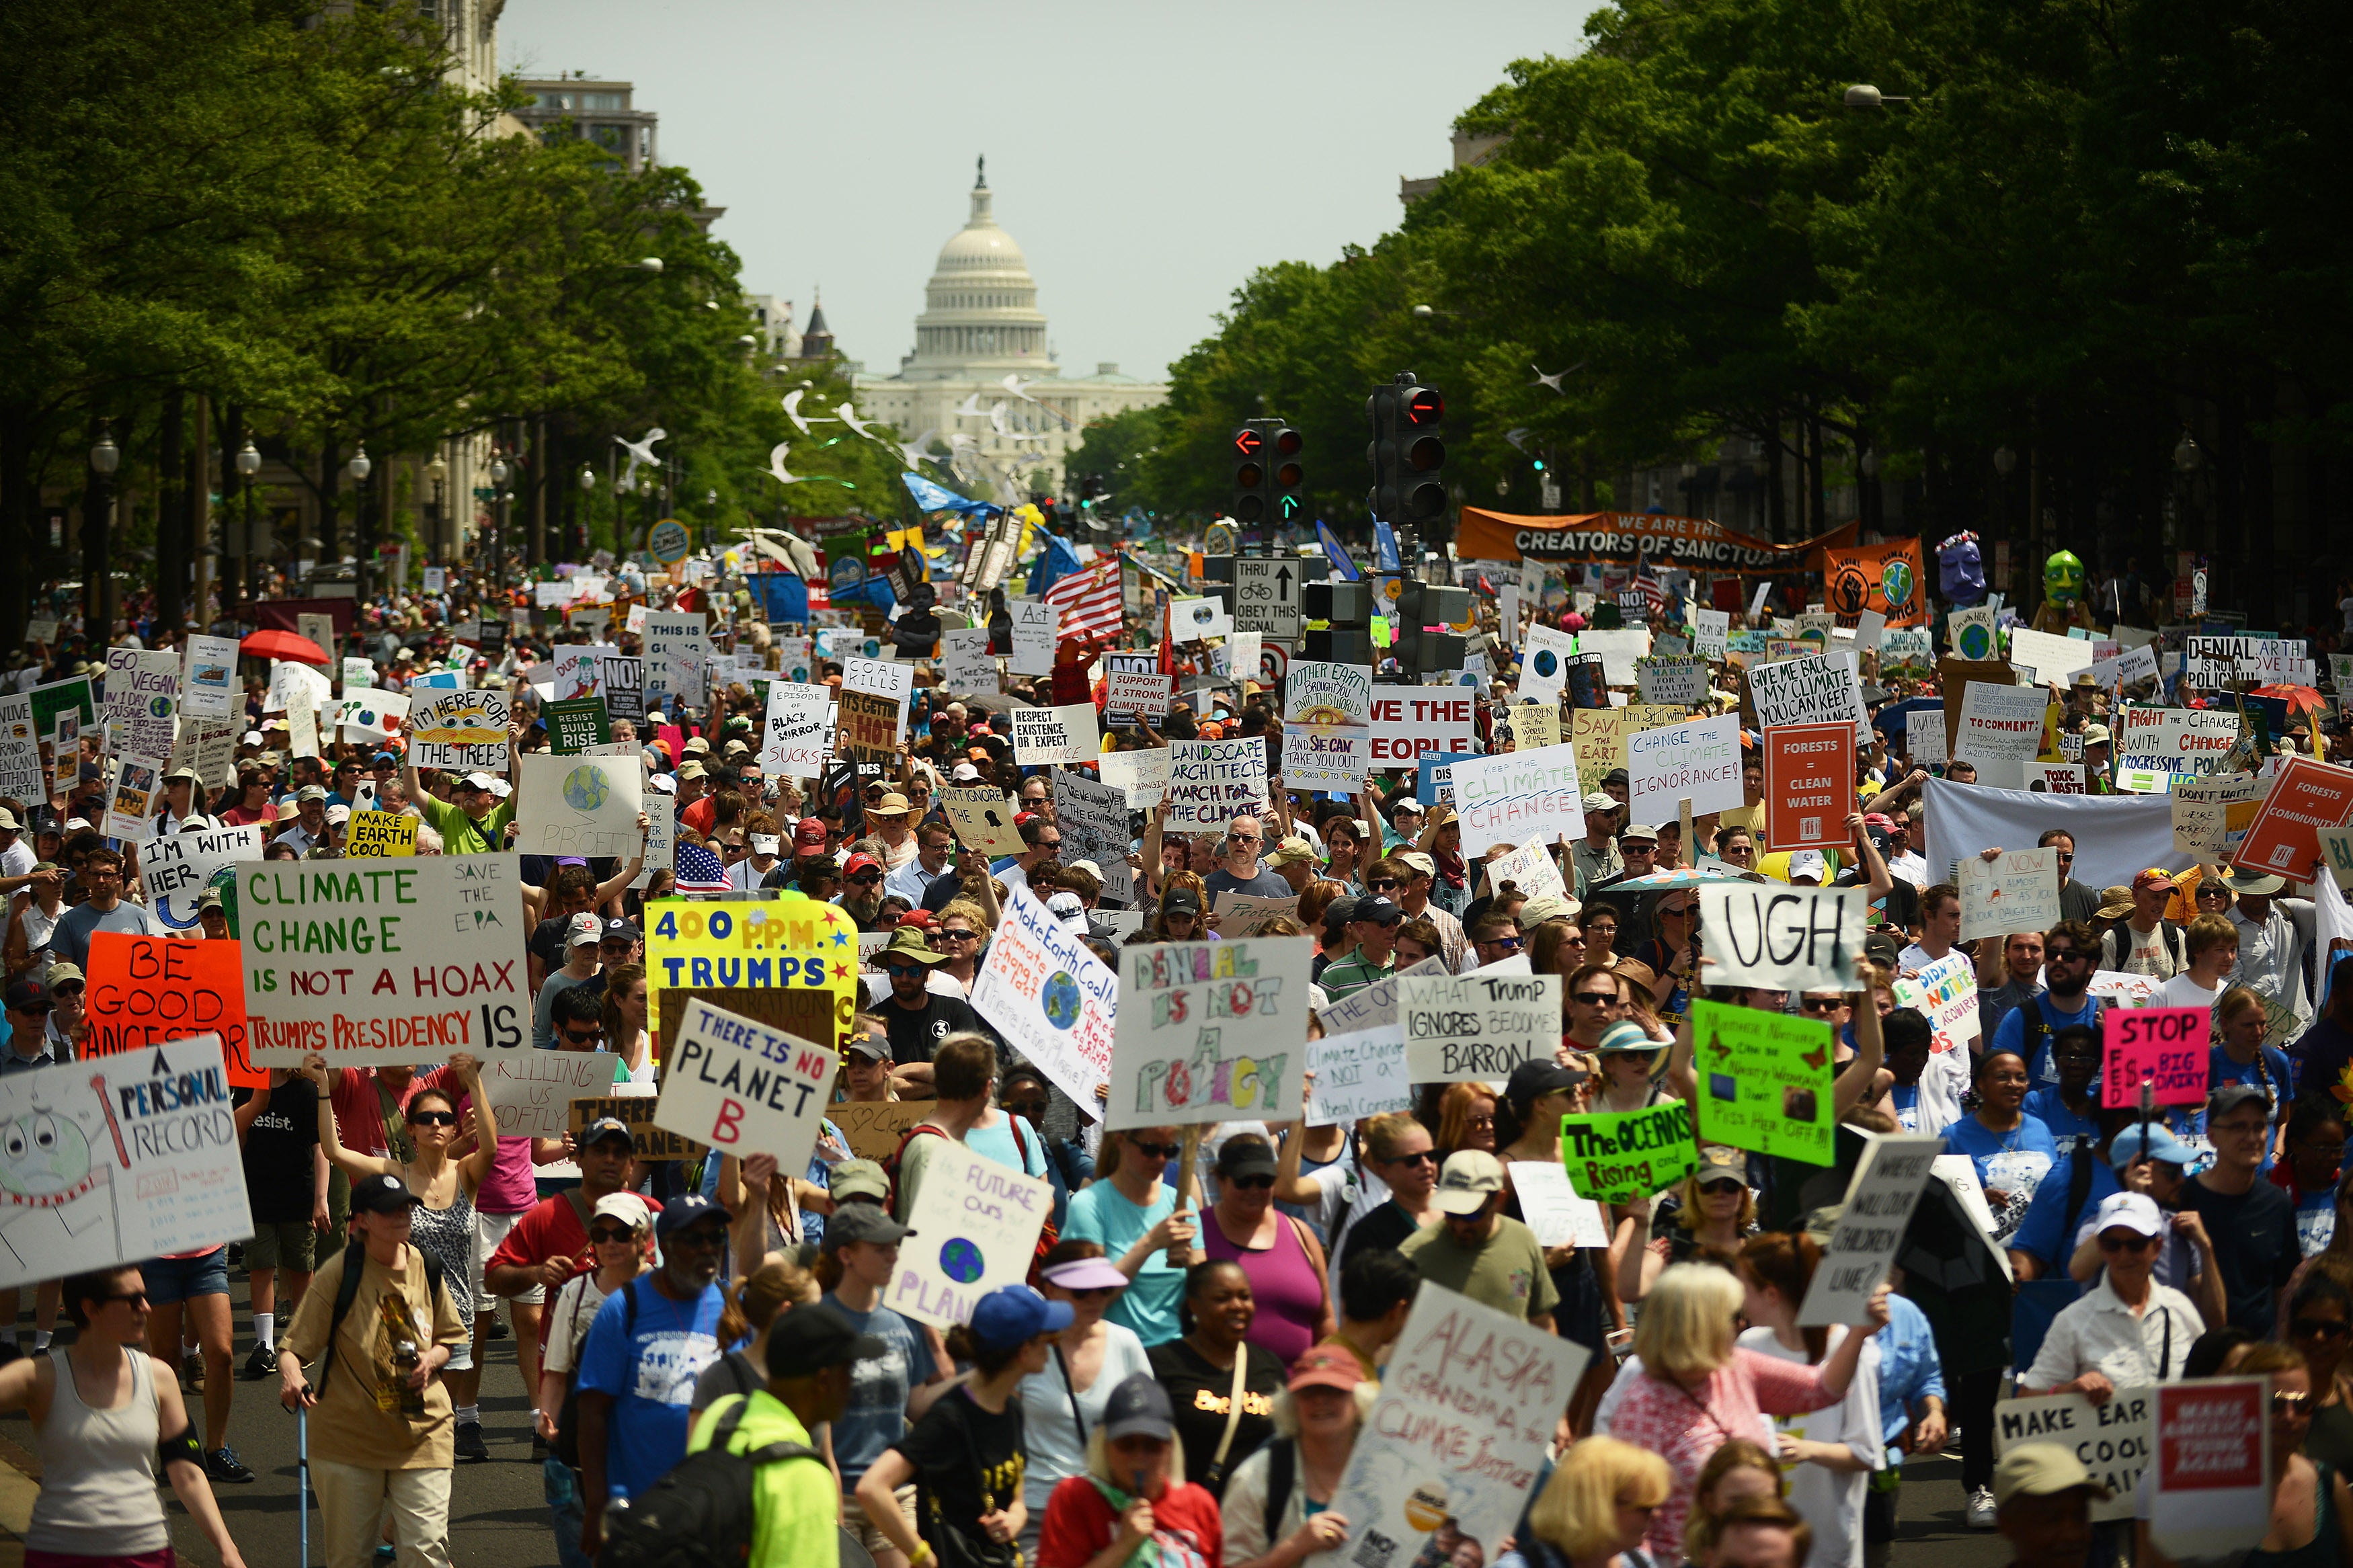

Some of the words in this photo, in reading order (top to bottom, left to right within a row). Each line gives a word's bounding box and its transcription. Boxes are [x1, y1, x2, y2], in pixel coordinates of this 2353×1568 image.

[1618, 516, 1644, 530] WE
[1650, 518, 1686, 532] ARE
[1515, 530, 1636, 552] CREATORS
[1638, 535, 1667, 554] OF
[1239, 564, 1269, 576] THRU
[1022, 605, 1049, 622] Act
[1238, 605, 1267, 617] OBEY
[1273, 606, 1296, 618] THIS
[651, 625, 683, 636] THIS
[686, 626, 699, 636] IS
[1238, 620, 1277, 632] SIGNAL
[951, 638, 967, 651] Tar
[1531, 635, 1550, 645] GOLDEN
[2188, 638, 2255, 660] DENIAL
[108, 651, 138, 670] GO
[849, 660, 900, 677] COAL
[1567, 657, 1580, 665] NO
[1644, 657, 1701, 668] CLIMATE
[605, 659, 641, 689] NO!
[1652, 667, 1693, 676] MARCH
[1750, 667, 1776, 689] GIVE
[1780, 661, 1799, 682] ME
[1801, 654, 1831, 677] BACK
[130, 671, 177, 695] VEGAN
[785, 684, 811, 692] THIS
[848, 673, 899, 691] KILLS
[1116, 675, 1163, 687] SUPPORT
[1286, 663, 1328, 704] MOTHER
[1331, 663, 1371, 707] EARTH
[1651, 684, 1696, 692] HEALTHY
[1790, 668, 1853, 699] CLIMATE
[1976, 684, 2001, 694] KEEP
[106, 692, 117, 702] IN
[128, 692, 148, 706] DAY
[776, 692, 820, 700] EPISODE
[1123, 688, 1164, 700] STRONG
[1314, 693, 1332, 706] THIS
[1654, 692, 1691, 700] PLANET
[1975, 694, 2048, 707] ENVIRONMENTAL
[435, 692, 476, 718] HERE
[480, 693, 510, 727] FOR
[1109, 700, 1145, 711] CLIMATE
[1148, 704, 1166, 712] BILL
[1410, 700, 1470, 722] THE
[1514, 706, 1554, 718] CHILDREN
[1667, 708, 1685, 722] with
[558, 713, 594, 723] RESIST
[772, 712, 806, 732] BLACK
[1015, 711, 1052, 723] RESPECT
[1970, 718, 1983, 727] TO
[2128, 709, 2165, 729] FIGHT
[2169, 716, 2182, 725] THE
[561, 723, 596, 733] BUILD
[777, 721, 822, 741] MIRROR
[856, 715, 898, 748] HOT
[1016, 723, 1064, 735] EXISTENCE
[563, 733, 598, 747] RISE
[1018, 736, 1031, 747] OR
[1035, 734, 1068, 746] EXPECT
[1289, 735, 1309, 751] AND
[1329, 739, 1353, 753] CAN
[1633, 731, 1690, 753] CHANGE
[1698, 731, 1718, 741] THE
[1783, 740, 1837, 755] FORESTS
[2127, 734, 2159, 751] WITH
[418, 743, 451, 764] THE
[456, 743, 508, 766] TREES
[768, 745, 820, 765] SUCKS
[1171, 739, 1263, 761] LANDSCAPE
[1656, 742, 1730, 767] CLIMATE
[1285, 752, 1312, 764] TAKE
[1315, 753, 1334, 768] YOU
[1338, 755, 1359, 768] OUT
[1515, 759, 1537, 770] THE
[2120, 755, 2185, 773] PROGRESSIVE
[1172, 759, 1267, 780] ARCHITECTS
[1351, 774, 1364, 782] HER
[2044, 770, 2075, 782] TOXIC
[3, 784, 38, 797] EARTH
[1464, 765, 1576, 800] CLIMATE
[1634, 766, 1738, 797] IGNORANCE!
[1790, 778, 1832, 790] CLEAN
[2050, 782, 2084, 794] WASTE
[937, 787, 962, 802] DON'T
[966, 786, 1004, 803] IGNORE
[1225, 784, 1257, 800] FOR
[2178, 788, 2216, 800] DON'T
[2296, 782, 2342, 800] FORESTS
[1787, 794, 1832, 808] WATER
[356, 812, 403, 827] MAKE
[951, 807, 972, 823] THE
[1172, 806, 1197, 821] THE
[1470, 796, 1574, 829] CHANGE
[2181, 811, 2215, 821] WE'RE
[2268, 807, 2337, 828] COMMUNITY
[356, 827, 411, 845] EARTH
[1486, 833, 1501, 841] THE
[2176, 826, 2219, 836] ALREADY
[197, 831, 250, 854] WITH
[350, 843, 391, 857] COOL
[2005, 854, 2045, 871] NOW
[149, 864, 199, 893] HER
[454, 864, 501, 880] SAVE
[249, 870, 417, 905] CLIMATE
[2006, 877, 2040, 887] ALMOST
[460, 886, 493, 903] THE
[455, 910, 502, 932] EPA
[655, 911, 732, 940] 400
[1725, 893, 1843, 967] UGH
[253, 917, 401, 953] CHANGE
[130, 941, 196, 981] BE
[1135, 942, 1259, 991] DENIAL
[254, 969, 277, 992] IS
[290, 969, 354, 995] NOT
[372, 968, 397, 995] A
[413, 960, 514, 997] HOAX
[663, 957, 825, 987] TRUMPS
[1404, 977, 1475, 1004] WHAT
[95, 985, 223, 1022] GOOD
[1152, 989, 1191, 1030] IS
[1207, 977, 1282, 1021] NOT
[1322, 996, 1370, 1027] THE
[333, 1011, 471, 1050] PRESIDENCY
[482, 1004, 522, 1048] IS
[1408, 1011, 1481, 1036] IGNORES
[1488, 1011, 1560, 1034] BECOMES
[2120, 1014, 2198, 1044] STOP
[699, 1009, 760, 1050] THERE
[760, 1034, 791, 1063] IS
[795, 1049, 825, 1081] NO
[497, 1056, 594, 1086] KILLING
[2158, 1052, 2196, 1075] BIG
[677, 1039, 815, 1117] PLANET
[1136, 1053, 1288, 1113] POLICY
[2153, 1069, 2206, 1091] DAIRY
[119, 1066, 226, 1120] PERSONAL
[530, 1087, 550, 1105] US
[712, 1098, 746, 1143] B
[132, 1108, 233, 1161] RECORD
[1585, 1161, 1652, 1191] Rising
[967, 1164, 1038, 1212] FUTURE
[1412, 1309, 1556, 1407] ALASKA
[1398, 1363, 1519, 1440] GRANDMA
[2001, 1408, 2075, 1440] MAKE
[1455, 1436, 1535, 1491] JUSTICE
